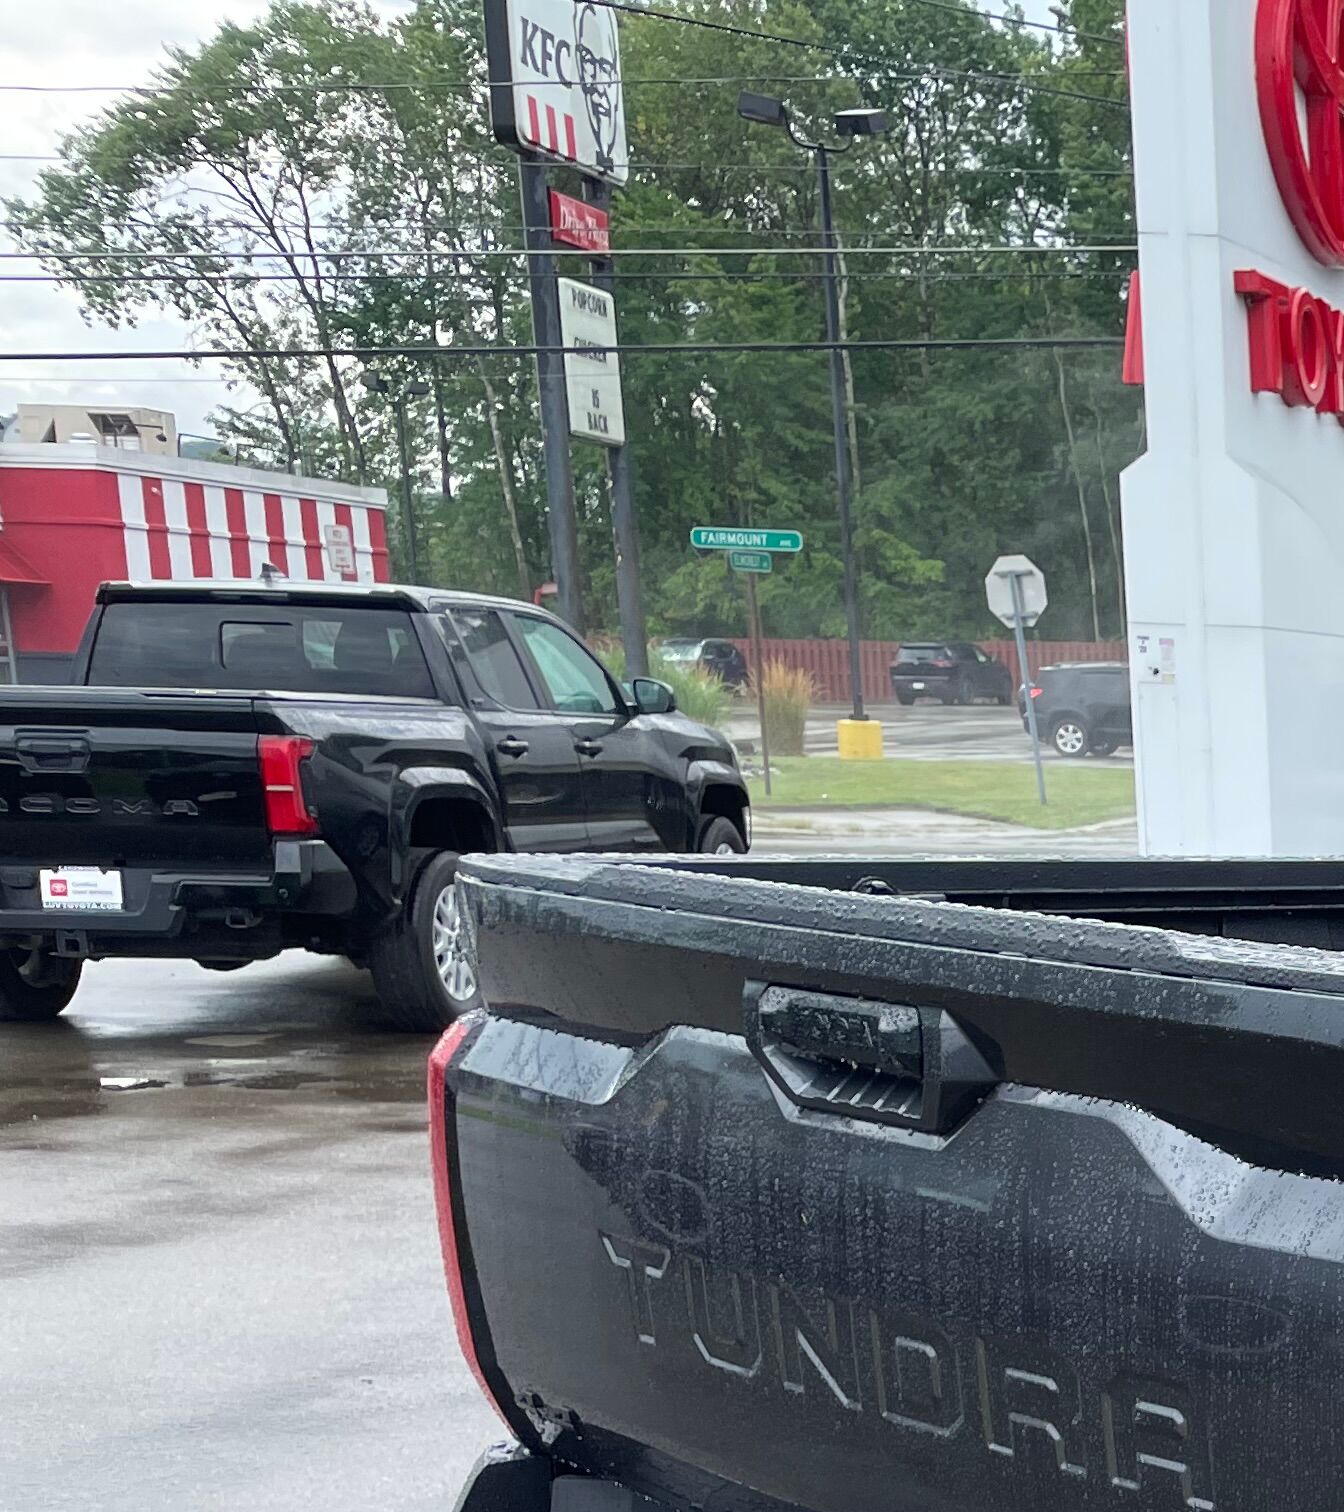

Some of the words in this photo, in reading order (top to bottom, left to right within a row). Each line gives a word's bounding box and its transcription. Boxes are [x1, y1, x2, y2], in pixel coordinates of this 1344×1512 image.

[519, 16, 573, 88] KFC
[571, 287, 608, 318] POPCORN
[591, 388, 600, 409] IS
[586, 411, 609, 434] BACK
[700, 531, 767, 546] FAIRMOUNT
[0, 796, 199, 816] COMA
[600, 1228, 1215, 1512] TUNDRA
